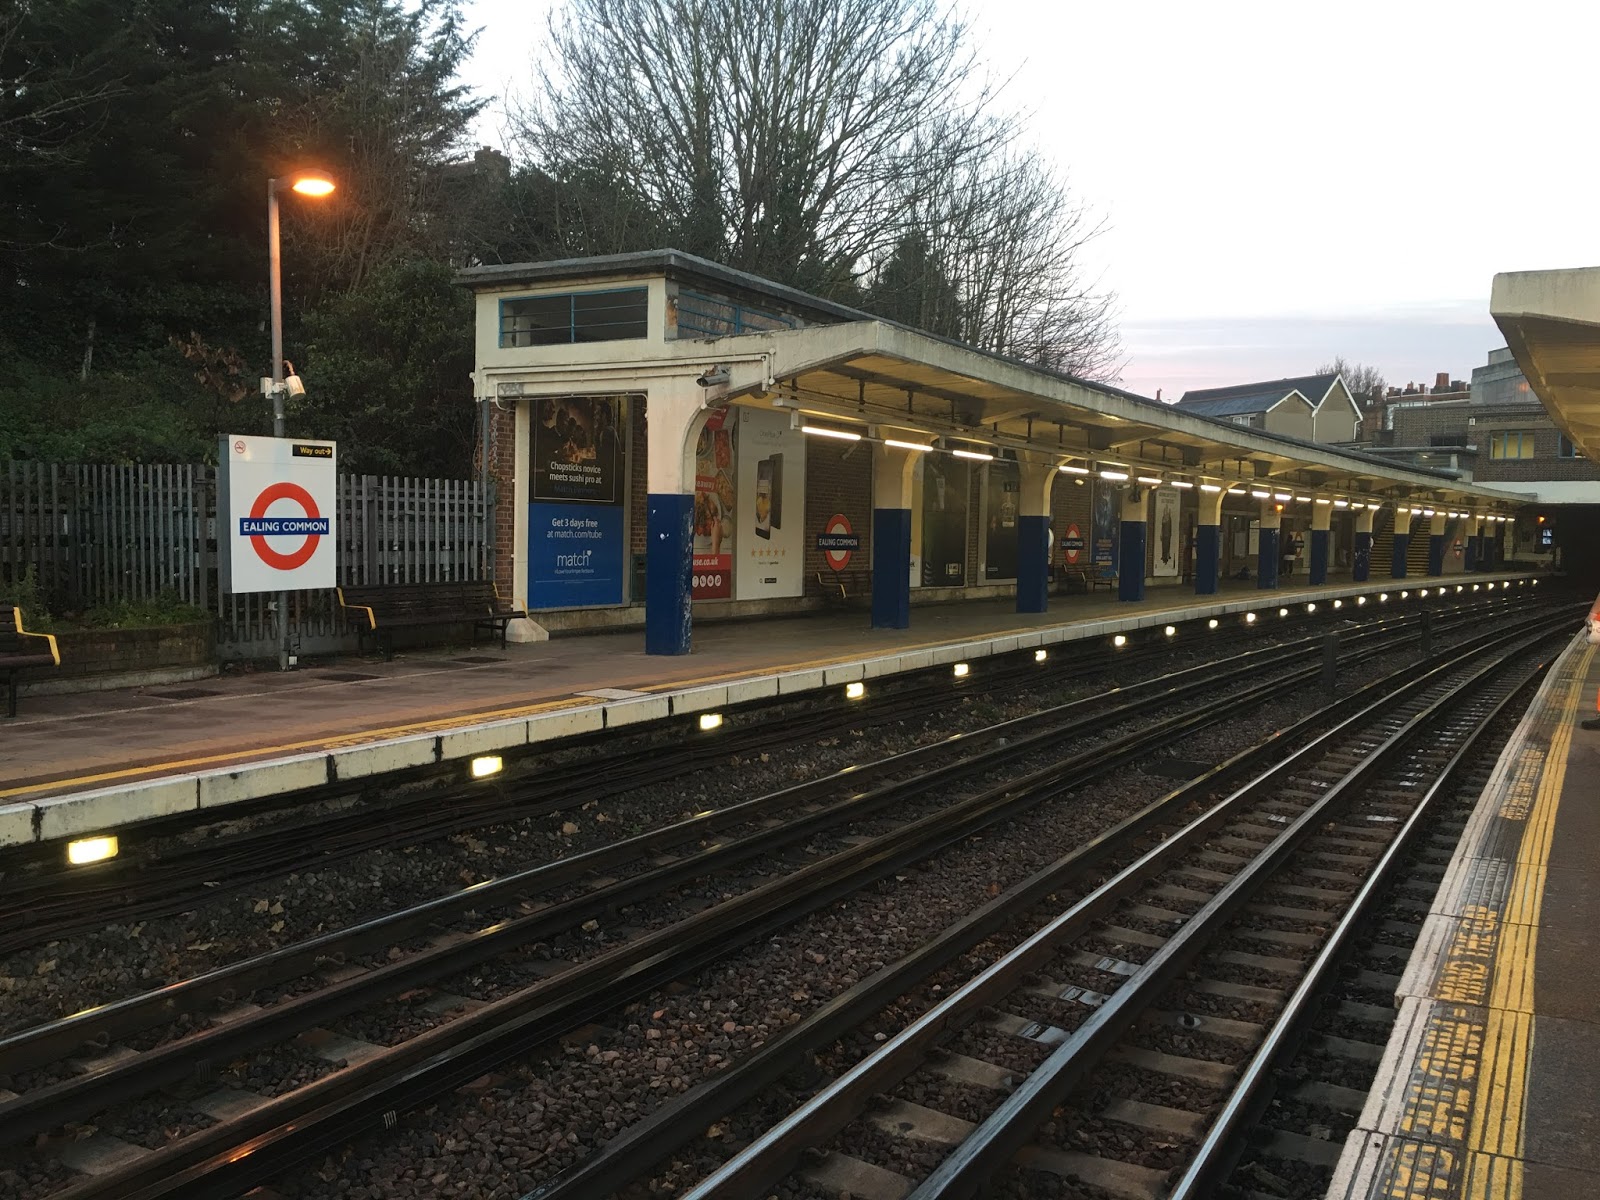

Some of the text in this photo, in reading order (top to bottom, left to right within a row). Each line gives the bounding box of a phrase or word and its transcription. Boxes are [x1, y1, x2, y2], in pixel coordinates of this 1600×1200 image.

[300, 447, 313, 456] Way
[551, 462, 582, 473] Chopsticks
[583, 466, 601, 474] novice
[549, 473, 569, 482] meets
[569, 474, 584, 483] sushi
[585, 477, 595, 485] pro
[243, 521, 327, 532] EALING COMMON
[552, 518, 598, 529] Get 3 days free
[546, 529, 602, 539] at match.com/tube
[819, 538, 858, 546] EALING COMMON
[556, 550, 589, 567] match
[1459, 904, 1498, 932] GAP
[1447, 931, 1497, 959] THE
[1434, 961, 1489, 1005] MIND
